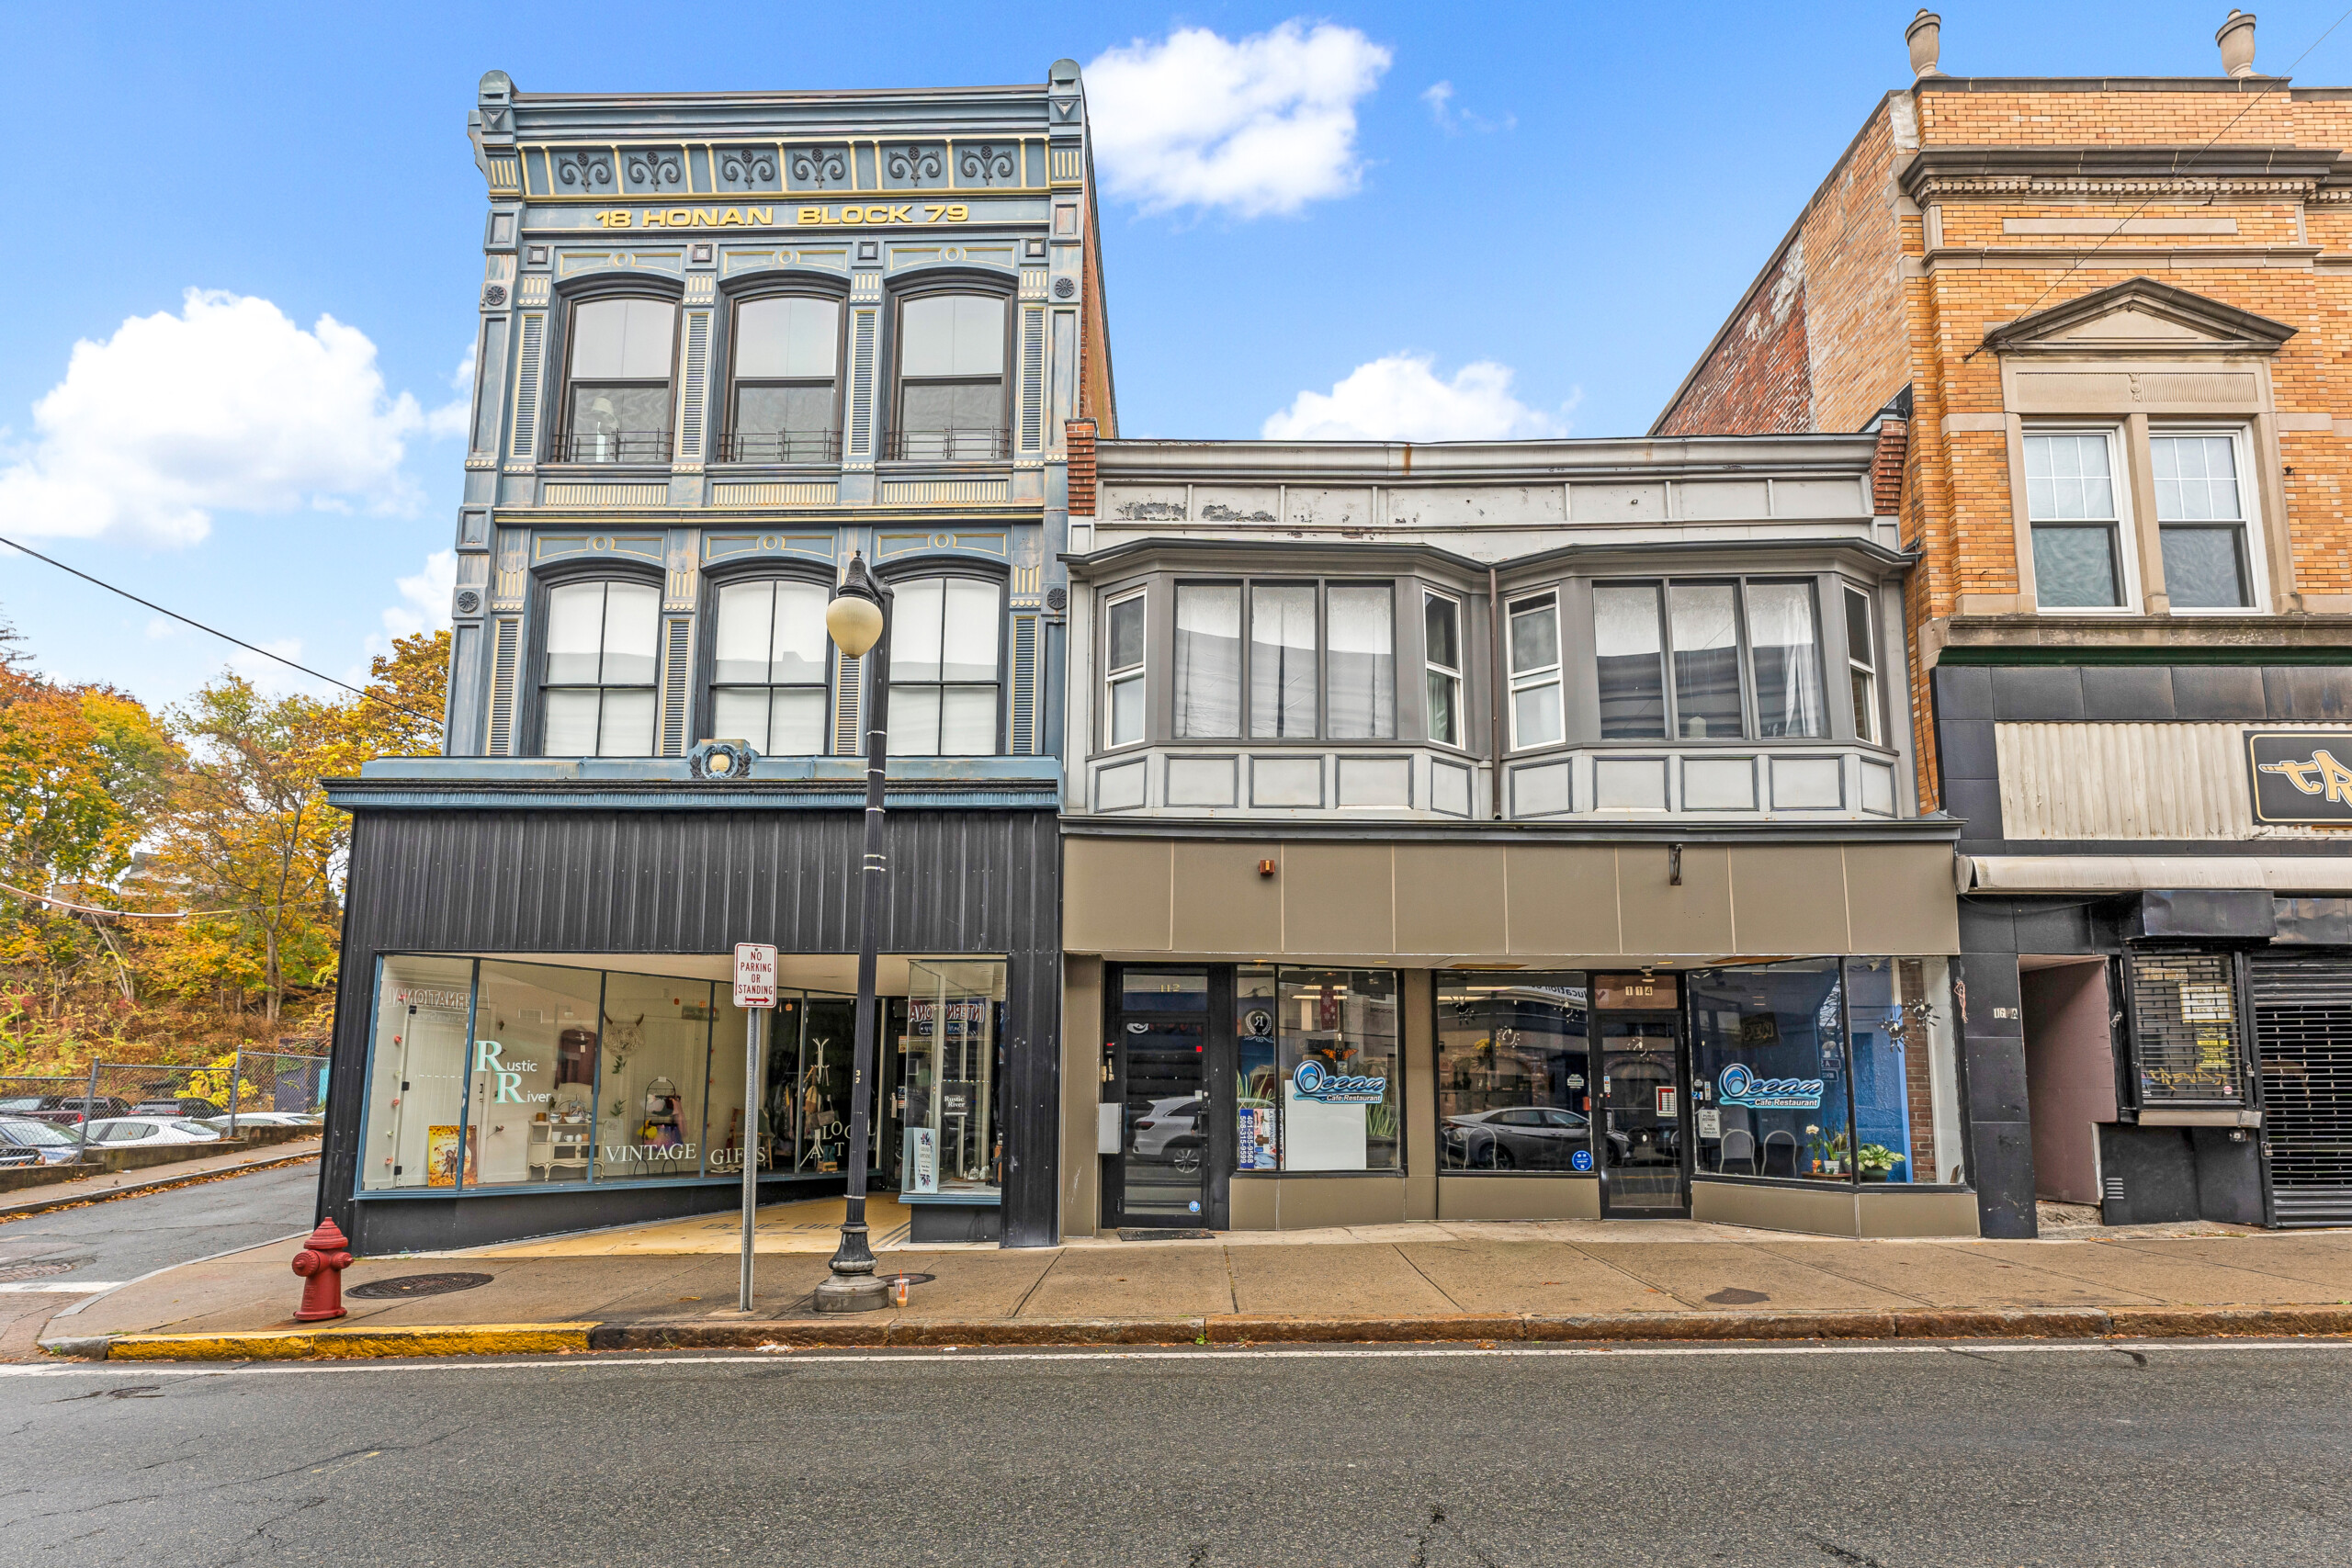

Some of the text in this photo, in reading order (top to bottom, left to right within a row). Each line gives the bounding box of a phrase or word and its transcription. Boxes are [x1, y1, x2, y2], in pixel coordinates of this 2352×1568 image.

[595, 204, 969, 228] 18 HONAN BLOCK 79
[751, 952, 763, 961] NO
[741, 962, 772, 973] PARKING
[751, 974, 761, 983] OR
[738, 984, 773, 995] STANDING
[1626, 987, 1653, 996] 114
[473, 1040, 537, 1072] Rustic
[1295, 1061, 1385, 1094] Ocean
[1722, 1065, 1822, 1098] Ocean
[493, 1072, 551, 1104] River
[822, 1118, 876, 1140] LOCL
[605, 1143, 697, 1162] VINTAGE
[709, 1146, 766, 1165] GIFS
